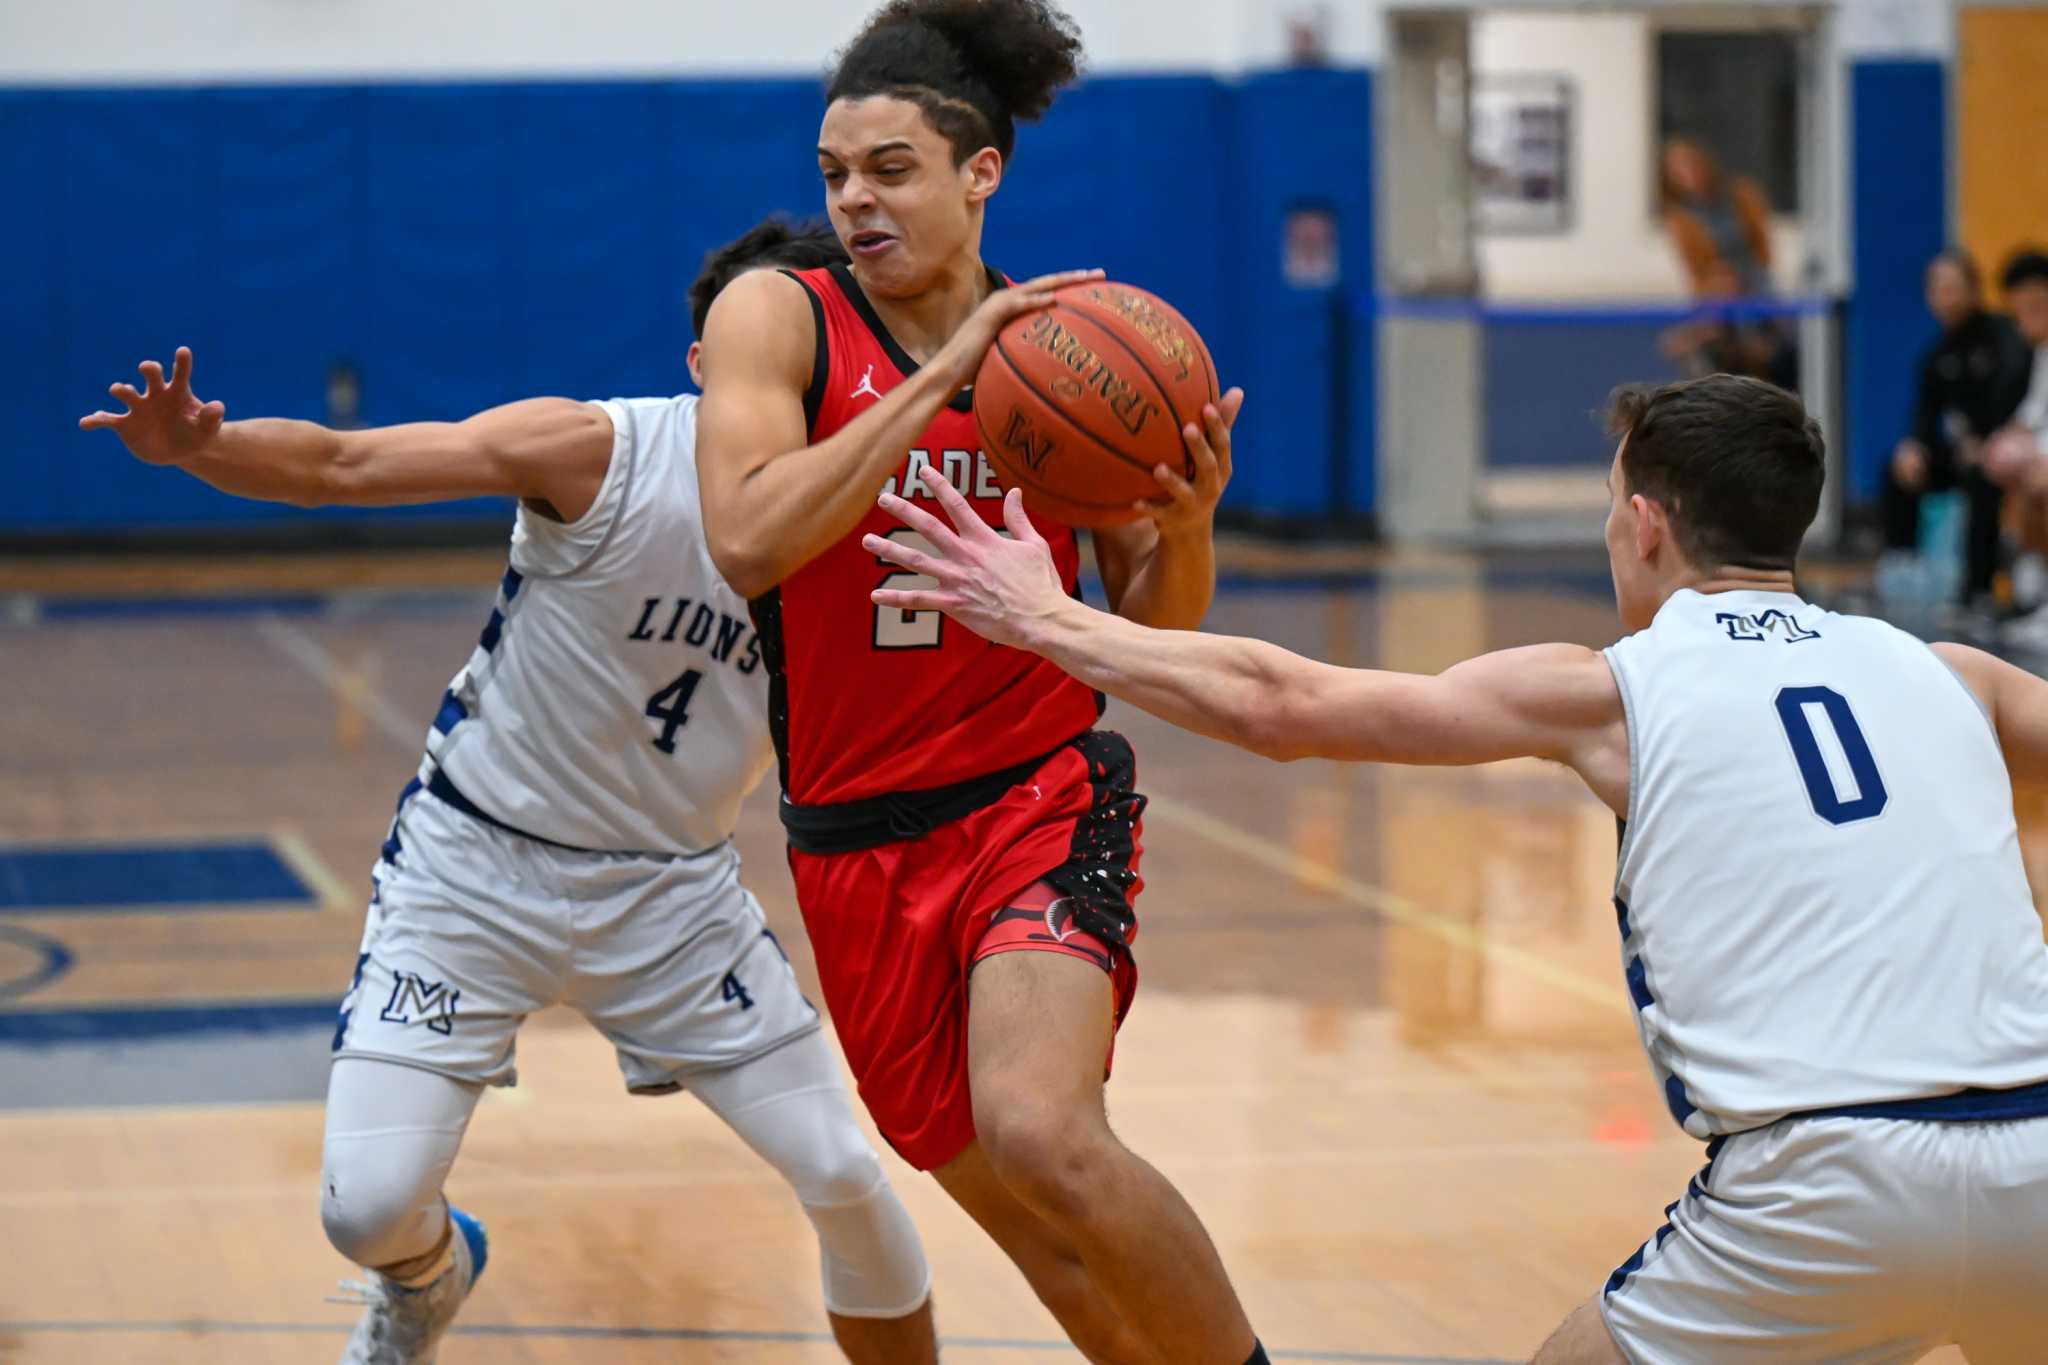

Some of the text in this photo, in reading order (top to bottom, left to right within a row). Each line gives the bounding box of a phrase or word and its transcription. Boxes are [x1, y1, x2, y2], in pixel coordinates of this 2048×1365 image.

[1020, 311, 1160, 435] SPALDING
[880, 448, 1004, 499] ADE
[629, 598, 761, 674] LIONS
[645, 669, 702, 754] 4
[1772, 684, 1889, 827] 0
[380, 970, 460, 1035] M
[722, 970, 754, 1010] 4
